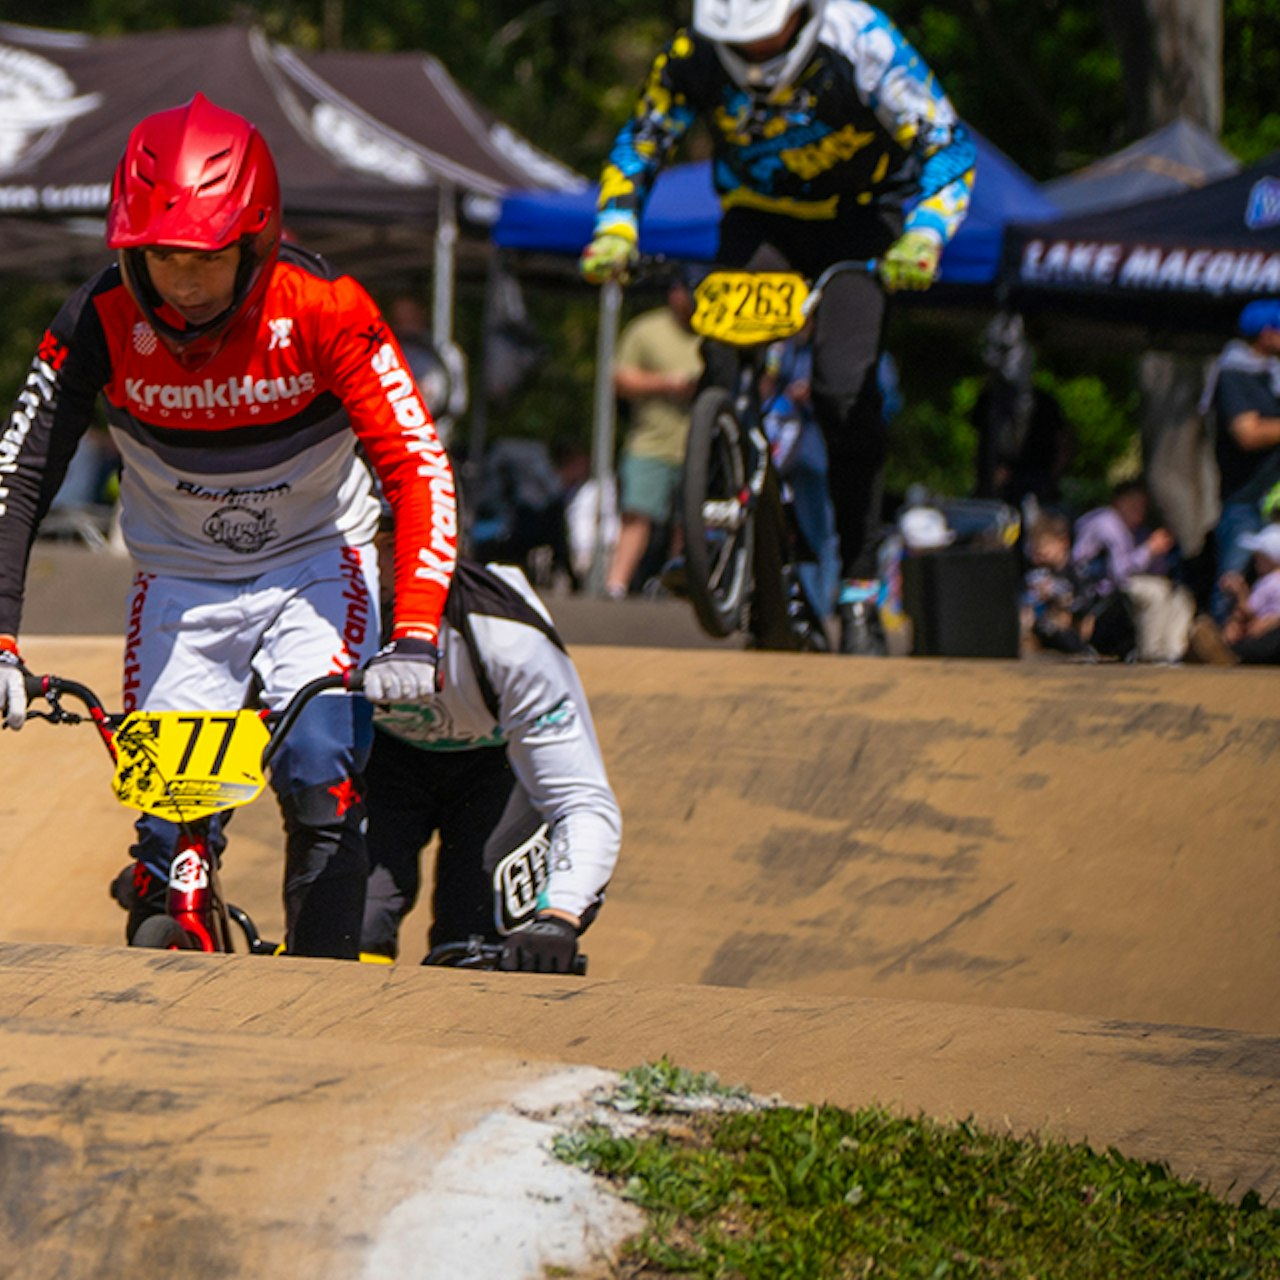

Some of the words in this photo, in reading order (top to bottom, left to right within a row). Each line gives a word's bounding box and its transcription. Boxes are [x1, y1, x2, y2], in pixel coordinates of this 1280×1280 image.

[1020, 239, 1122, 283] LAKE
[733, 283, 795, 317] 263
[125, 372, 316, 409] KrankHaus
[370, 343, 457, 588] KrankHaus
[176, 717, 237, 776] 77
